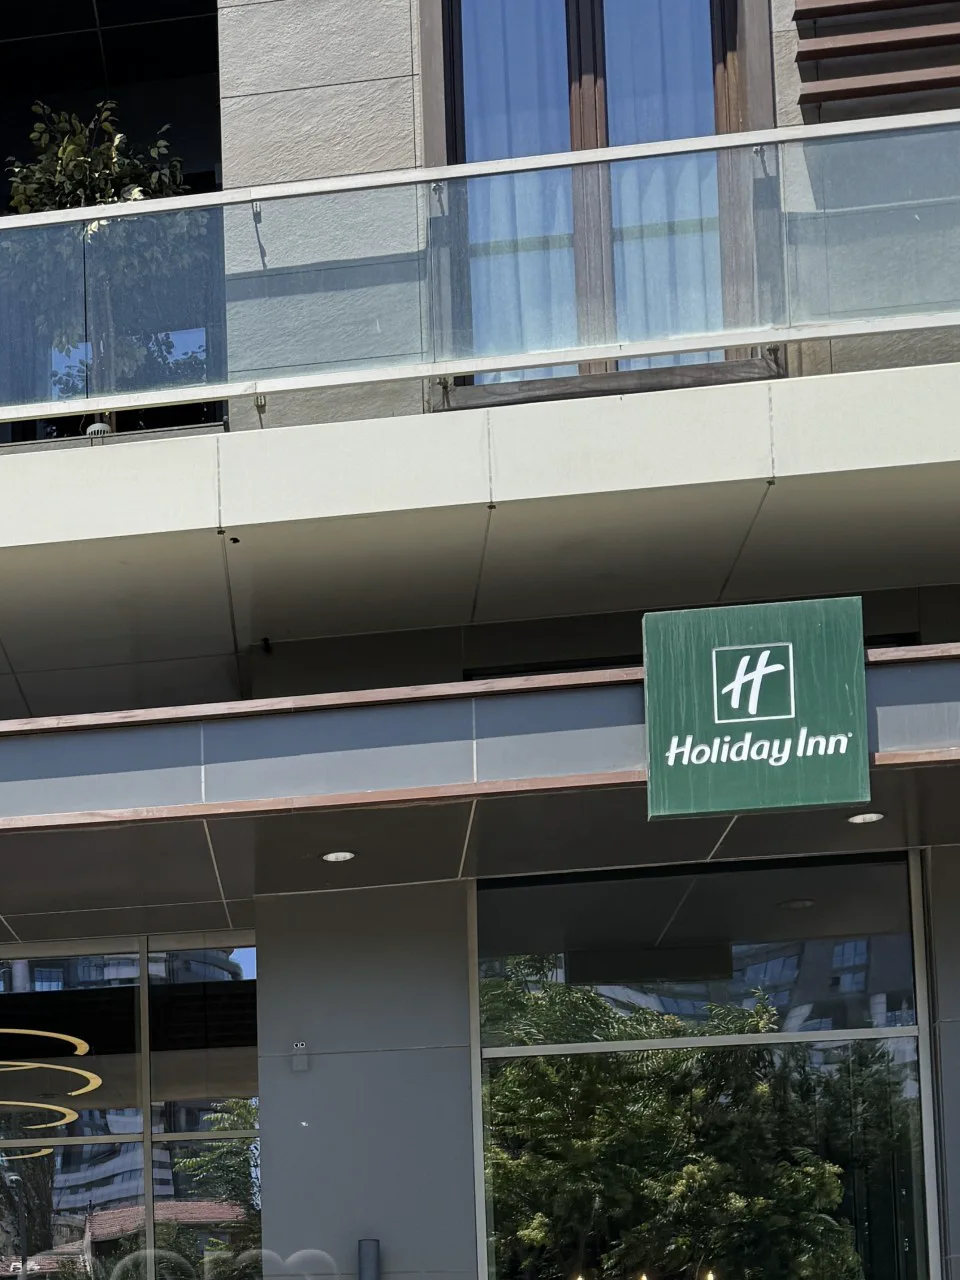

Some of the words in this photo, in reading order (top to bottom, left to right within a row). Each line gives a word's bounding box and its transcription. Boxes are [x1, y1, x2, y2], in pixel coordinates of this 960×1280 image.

[721, 650, 785, 715] H
[665, 732, 792, 767] Holiday
[797, 727, 851, 757] Inn
